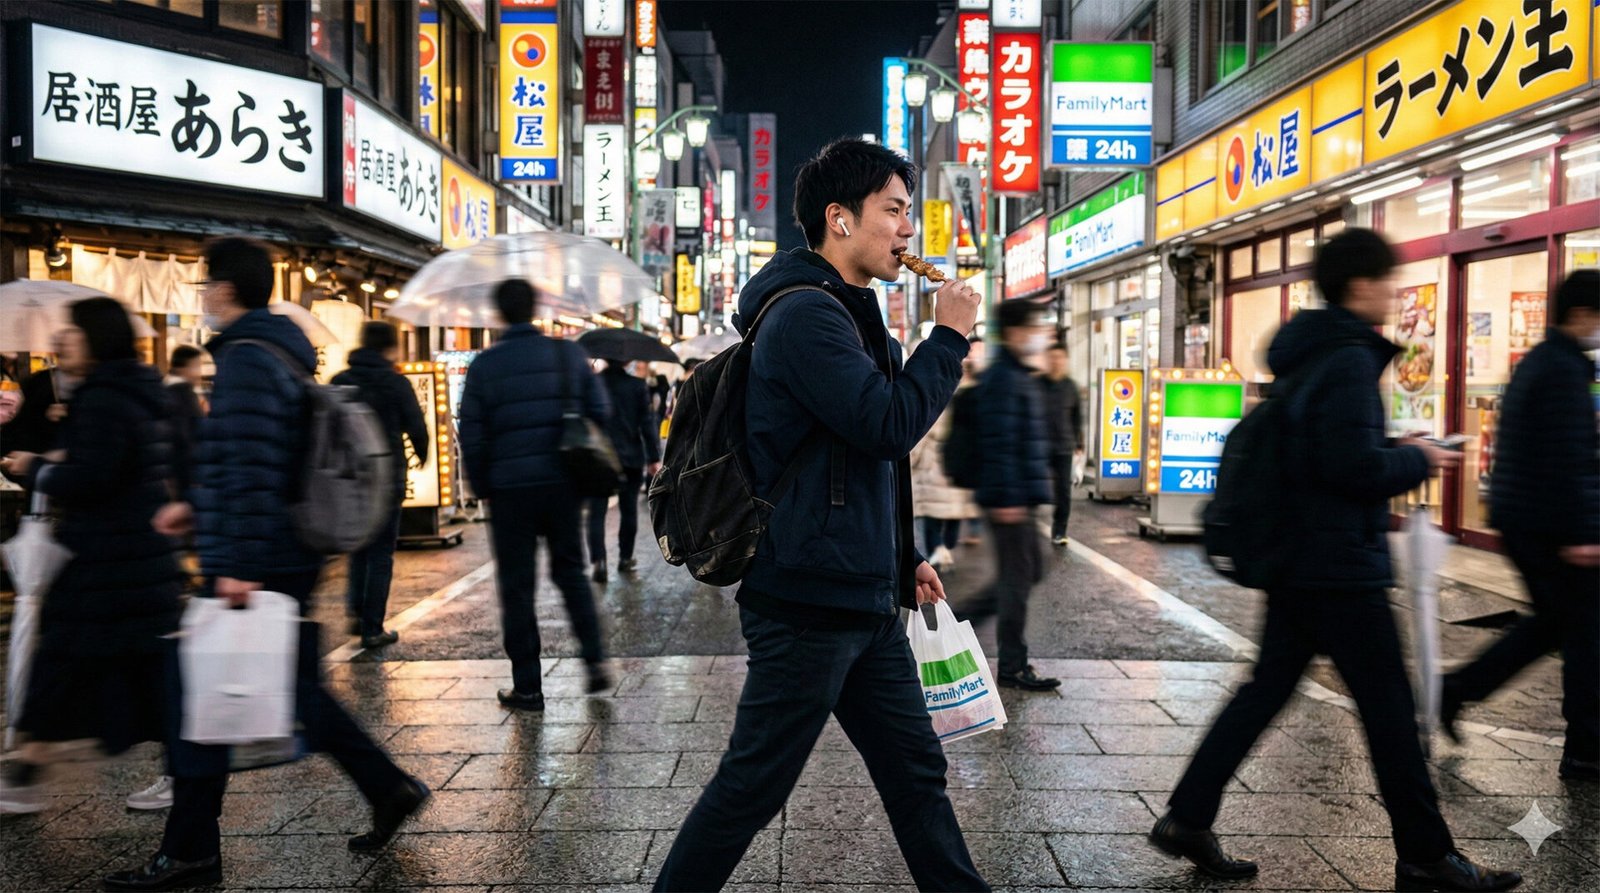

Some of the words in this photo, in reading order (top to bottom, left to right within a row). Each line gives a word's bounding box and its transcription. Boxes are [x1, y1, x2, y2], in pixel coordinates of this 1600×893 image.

[1374, 0, 1574, 139] ラーメン王
[41, 70, 161, 137] 居酒屋
[170, 78, 312, 173] あらき
[512, 76, 546, 147] 松屋
[999, 41, 1033, 183] カラオケ
[1057, 95, 1147, 113] FamilyMart
[512, 161, 546, 177] 24h
[753, 127, 771, 211] カラオケ
[1095, 139, 1137, 160] 24h
[1251, 110, 1299, 188] 松屋
[596, 131, 613, 223] ラーメン王
[1075, 219, 1114, 253] FamilyMart
[1111, 407, 1133, 453] 松屋
[1165, 429, 1226, 444] FamilyMa
[1110, 462, 1133, 475] 24h
[1179, 469, 1218, 490] 24h
[924, 676, 985, 703] FamilyMart
